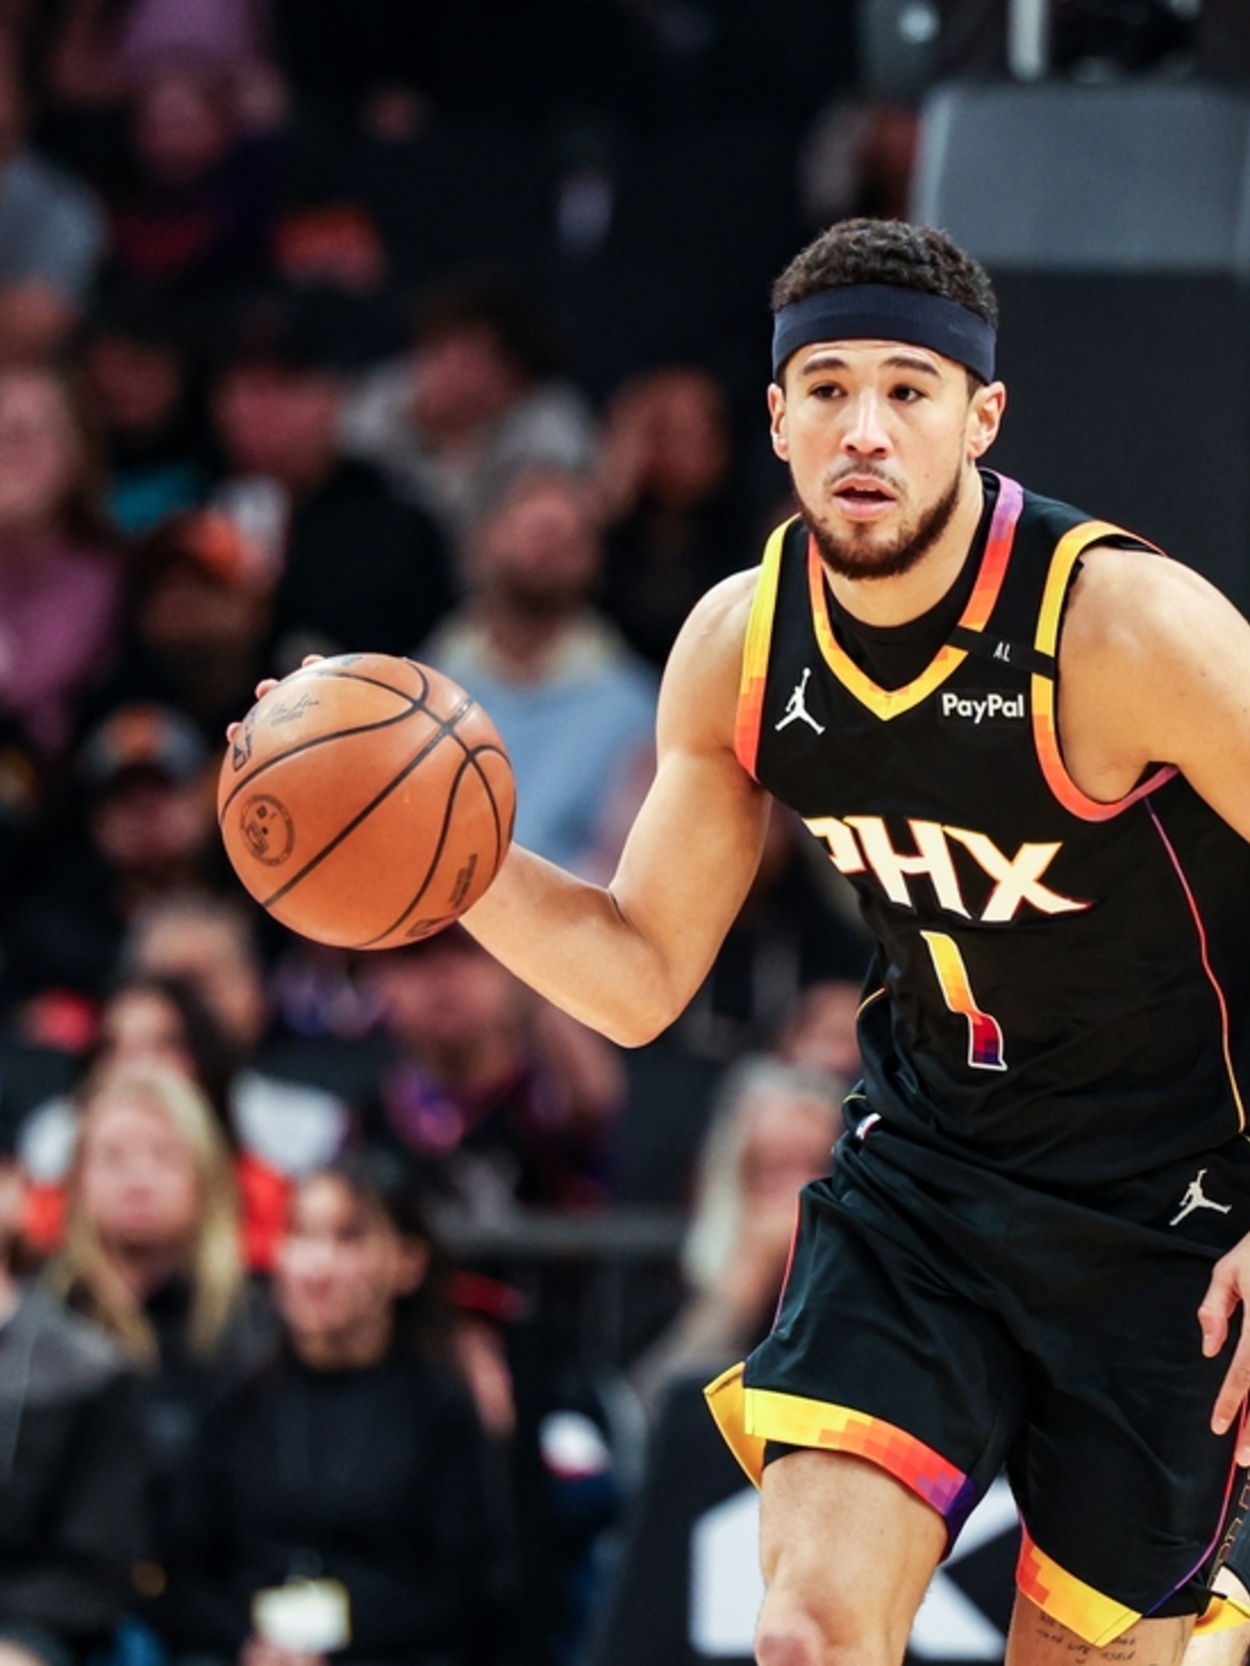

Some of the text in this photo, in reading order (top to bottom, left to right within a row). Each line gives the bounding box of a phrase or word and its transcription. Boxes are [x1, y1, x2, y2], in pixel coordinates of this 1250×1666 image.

[992, 641, 1011, 662] AL
[941, 692, 1024, 725] PayPal
[801, 815, 1093, 922] PHX
[919, 929, 1008, 1072] 1
